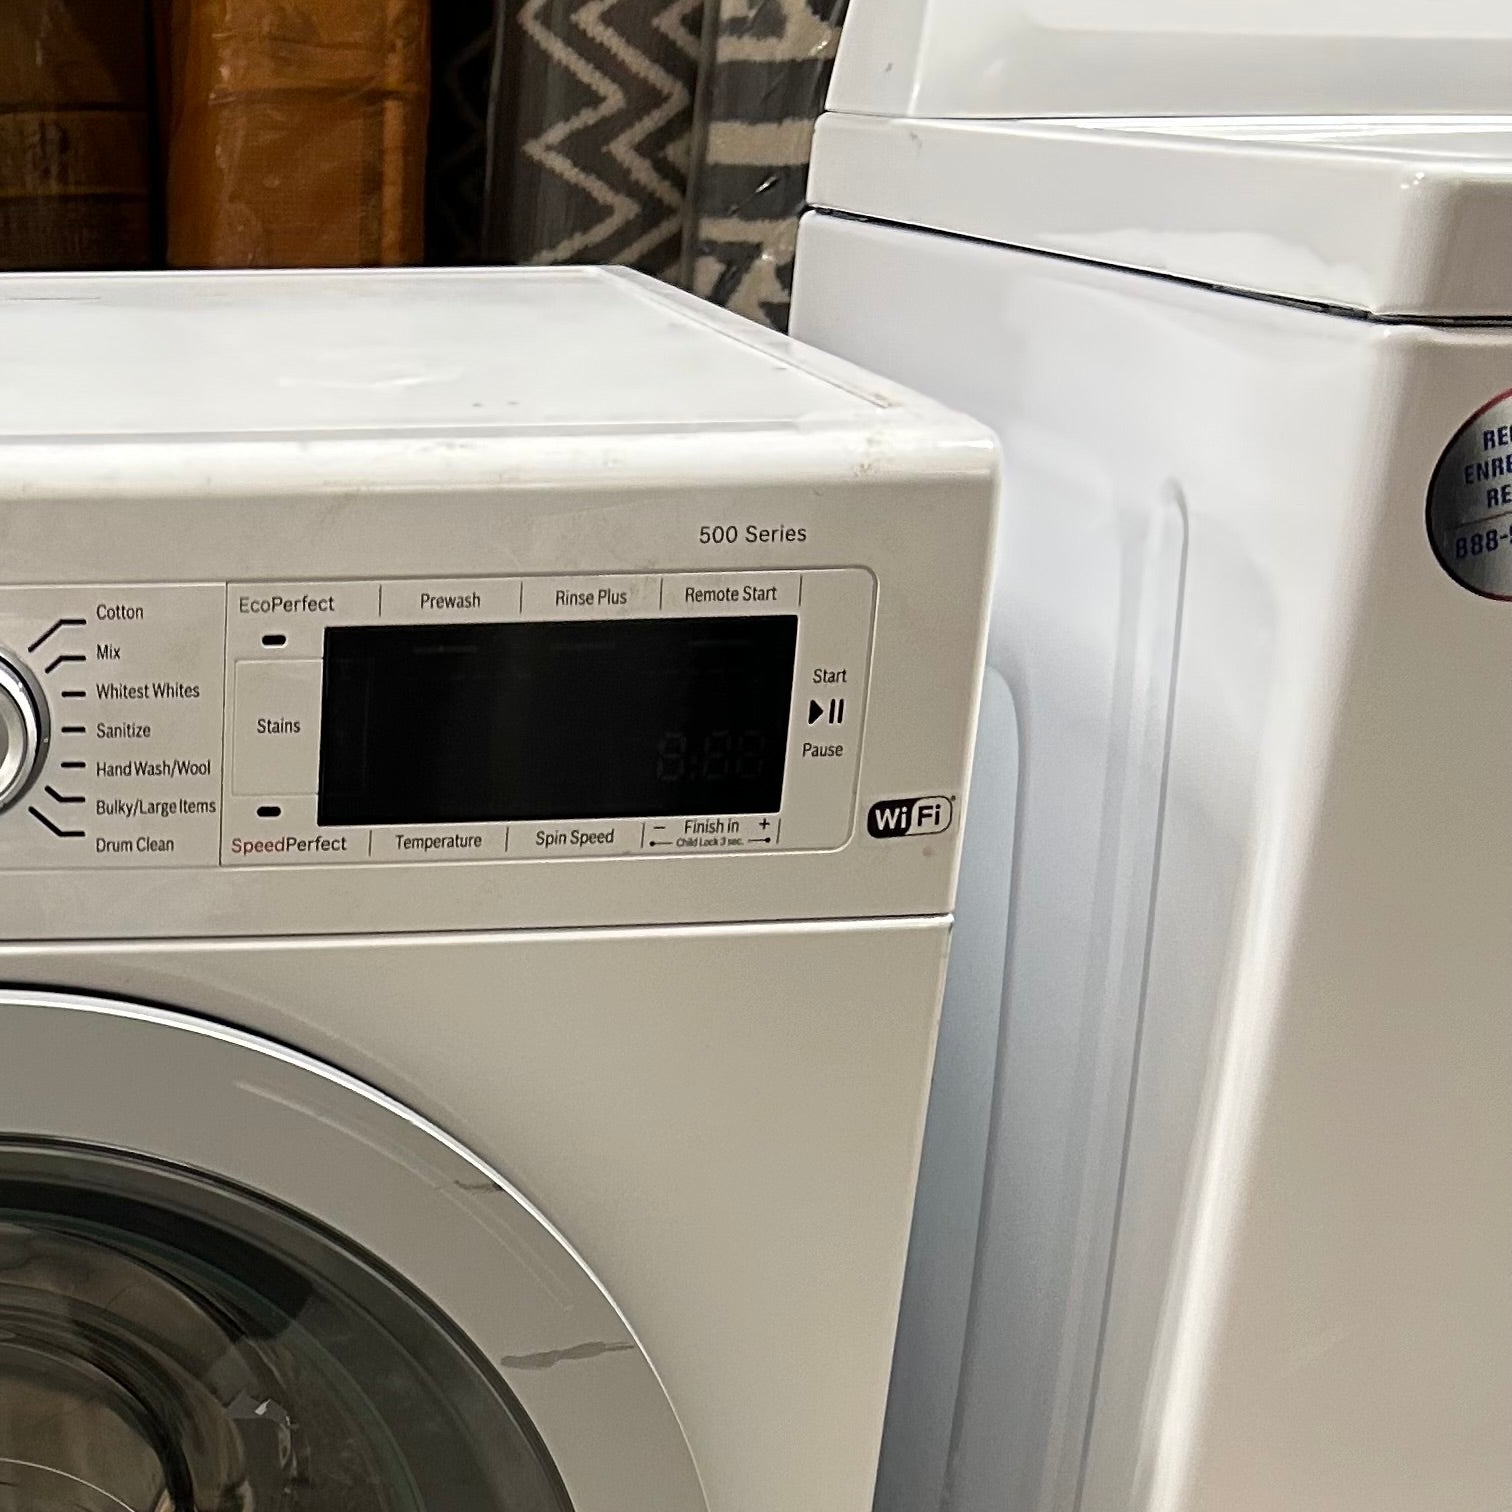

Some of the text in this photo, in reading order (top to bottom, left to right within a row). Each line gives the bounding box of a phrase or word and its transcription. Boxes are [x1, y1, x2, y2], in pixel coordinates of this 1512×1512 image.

[1483, 425, 1512, 451] RE
[699, 524, 807, 544] 500 Series
[420, 592, 482, 610] Prewash
[555, 588, 628, 607] Rinse Plus
[685, 586, 778, 604] Remote Start
[96, 604, 144, 620] Cotton
[239, 595, 336, 614] EcoPerfect
[96, 644, 121, 660] Mix
[812, 667, 848, 684] Start
[96, 682, 200, 700] Whitest Whites
[96, 721, 151, 739] Sanitize
[256, 717, 301, 735] Stains
[802, 742, 844, 758] Pause
[96, 760, 211, 778] Hand Wash/Wool
[96, 799, 216, 818] Bulky/Large Items
[685, 818, 739, 834] Finish in
[96, 837, 175, 853] Drum Clean
[231, 836, 347, 857] SpeedPerfect
[395, 833, 483, 853] Temperature
[535, 829, 615, 848] Spin Speed
[699, 836, 718, 847] Lock
